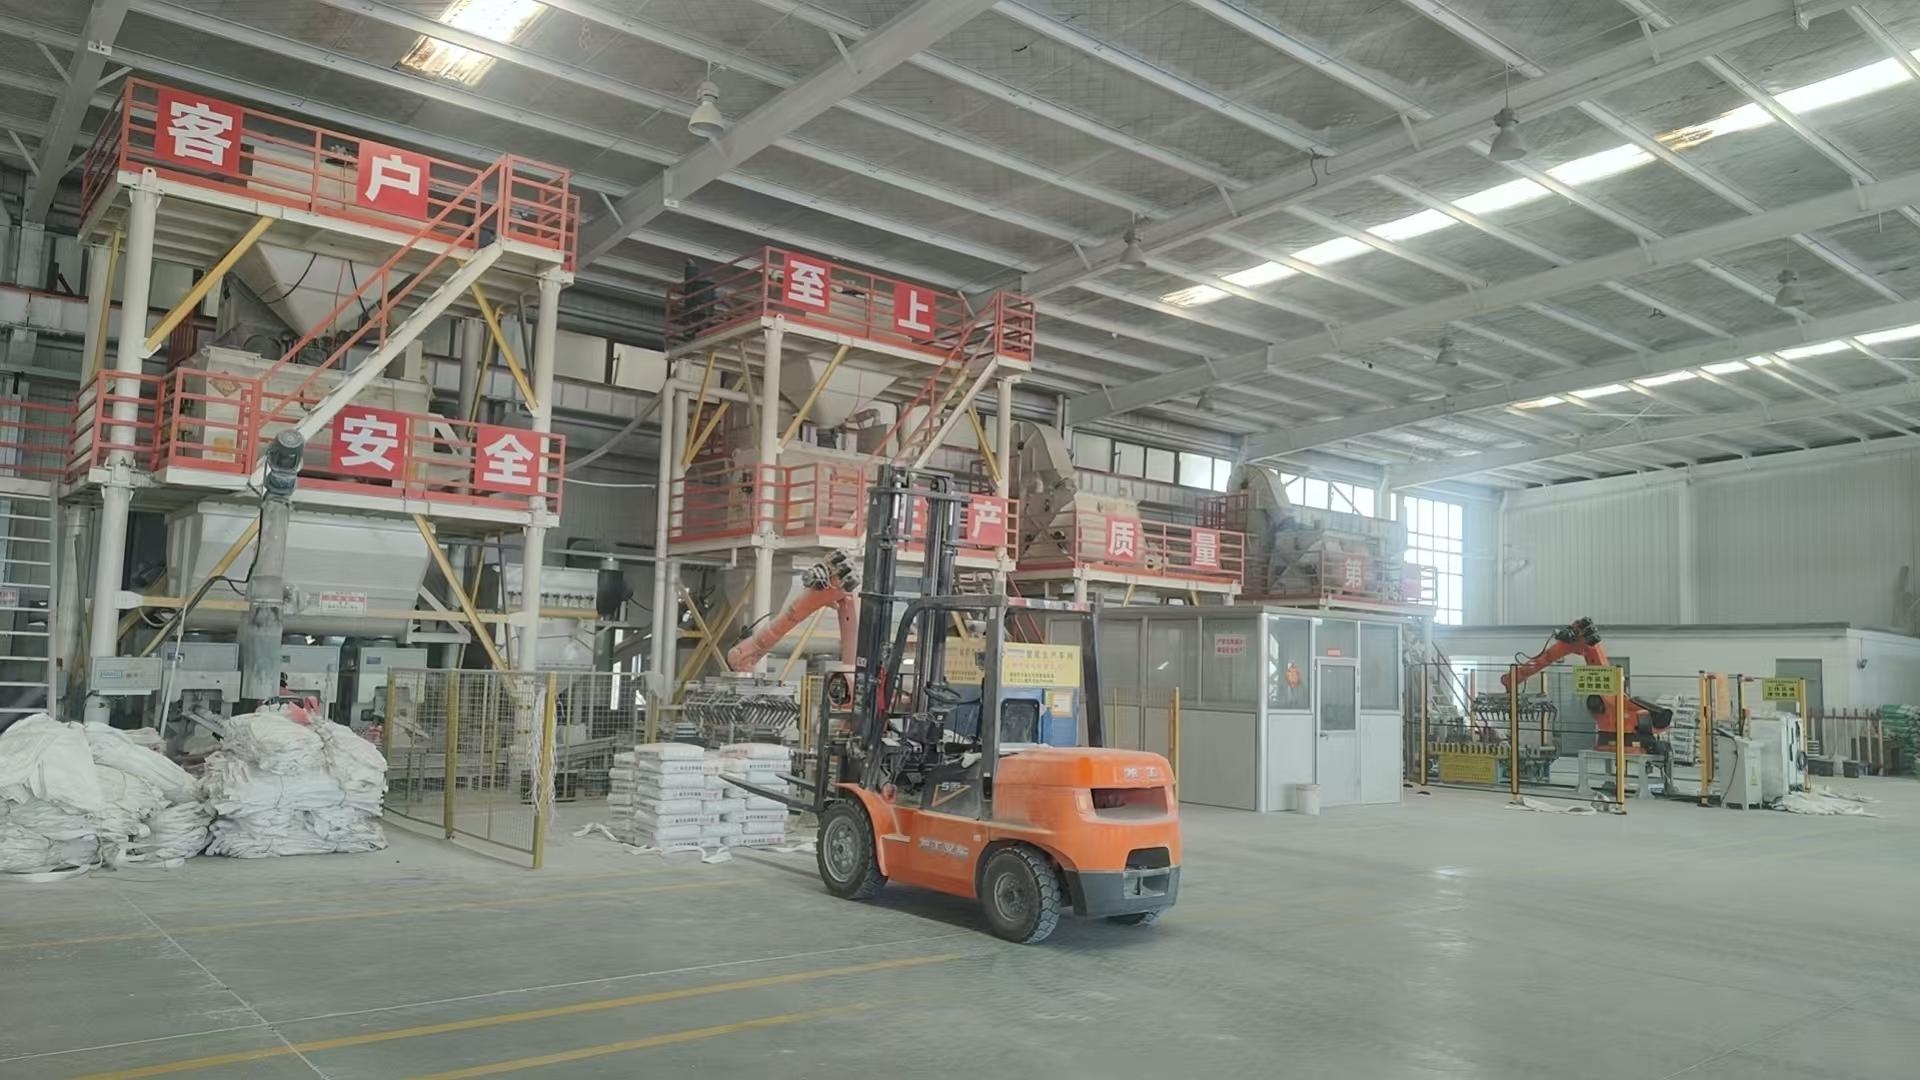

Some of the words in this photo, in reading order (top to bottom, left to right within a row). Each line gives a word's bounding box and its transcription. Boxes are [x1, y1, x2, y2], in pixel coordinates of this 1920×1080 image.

[168, 102, 233, 166] 客
[364, 154, 420, 201] 户
[788, 260, 825, 307] 至
[898, 290, 930, 332] 上
[340, 414, 398, 471] 安
[483, 434, 534, 486] 全
[972, 500, 1002, 537] 产
[1108, 520, 1136, 557] 质
[1194, 532, 1218, 566] 量
[1345, 558, 1362, 588] 第
